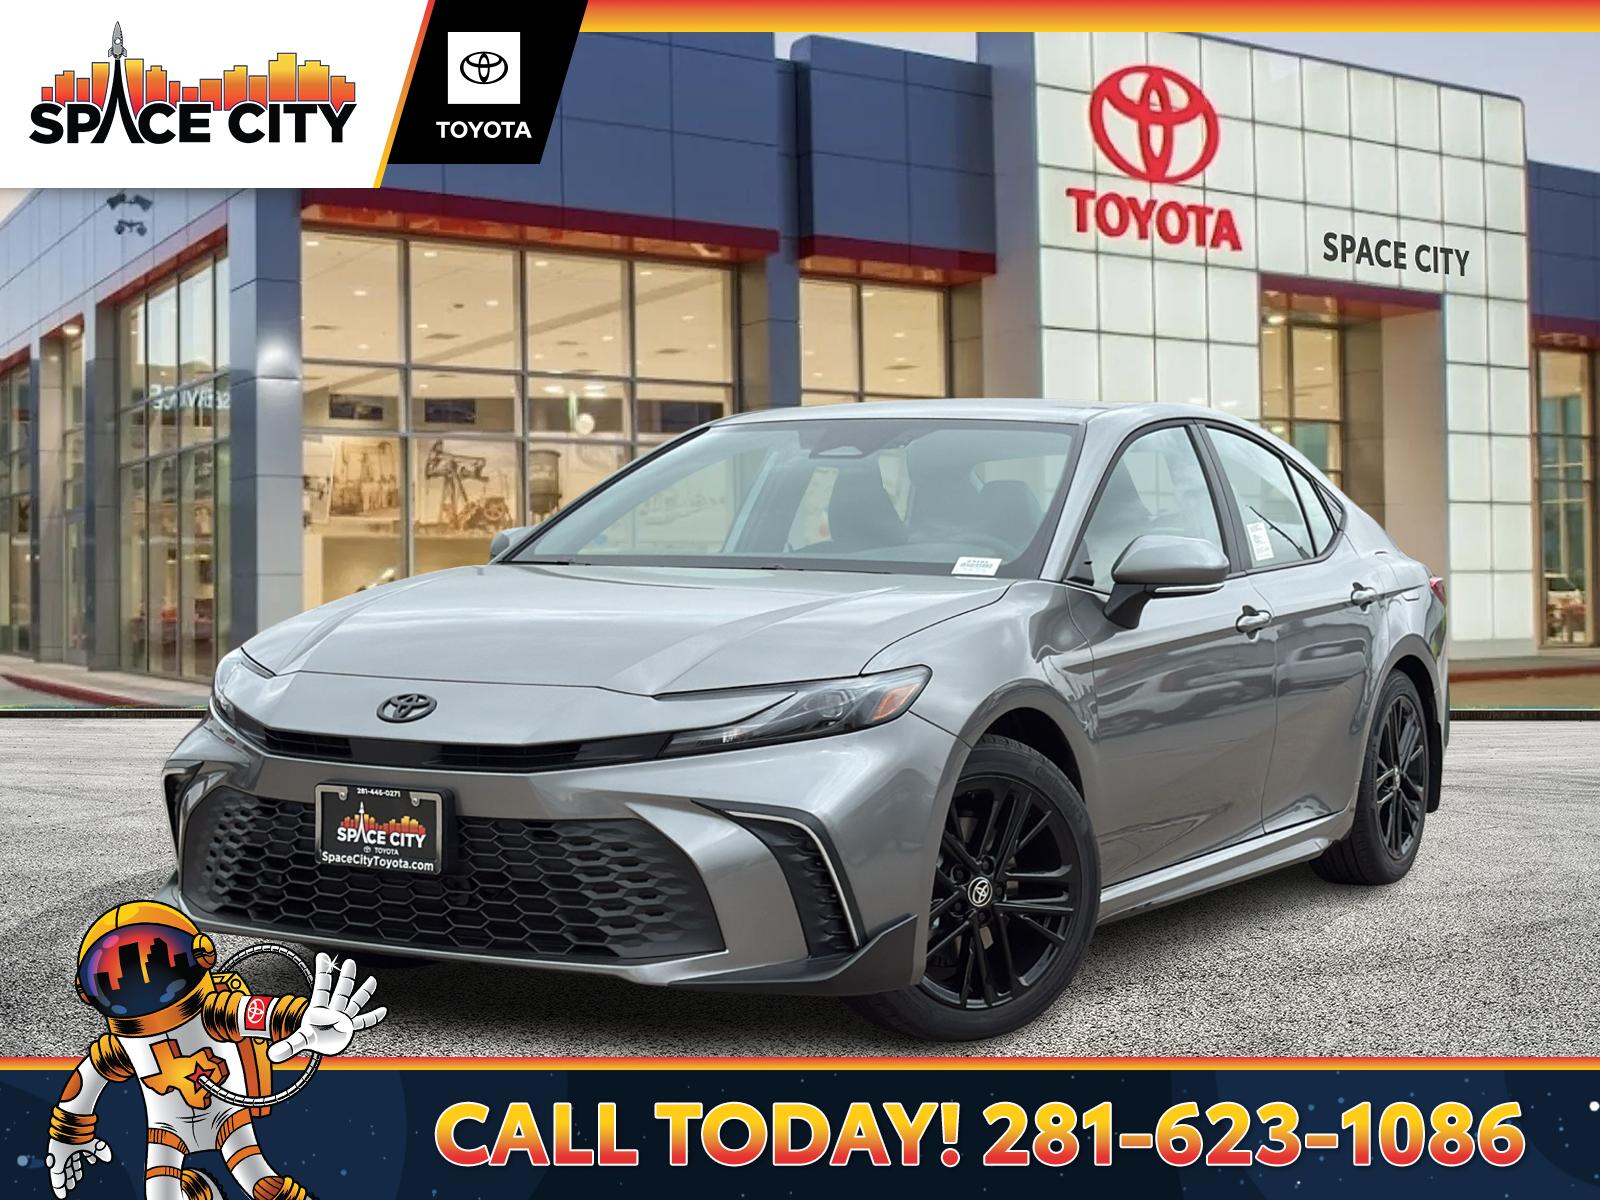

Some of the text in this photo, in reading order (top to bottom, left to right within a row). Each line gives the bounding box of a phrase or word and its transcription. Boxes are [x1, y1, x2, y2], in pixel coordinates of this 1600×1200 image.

[1066, 187, 1243, 252] TOYOTA
[1322, 231, 1471, 278] SPACE CITY
[337, 825, 426, 849] SPACE CITY
[321, 850, 434, 872] SpaceCityToyota.com
[374, 847, 399, 856] TOYOTA
